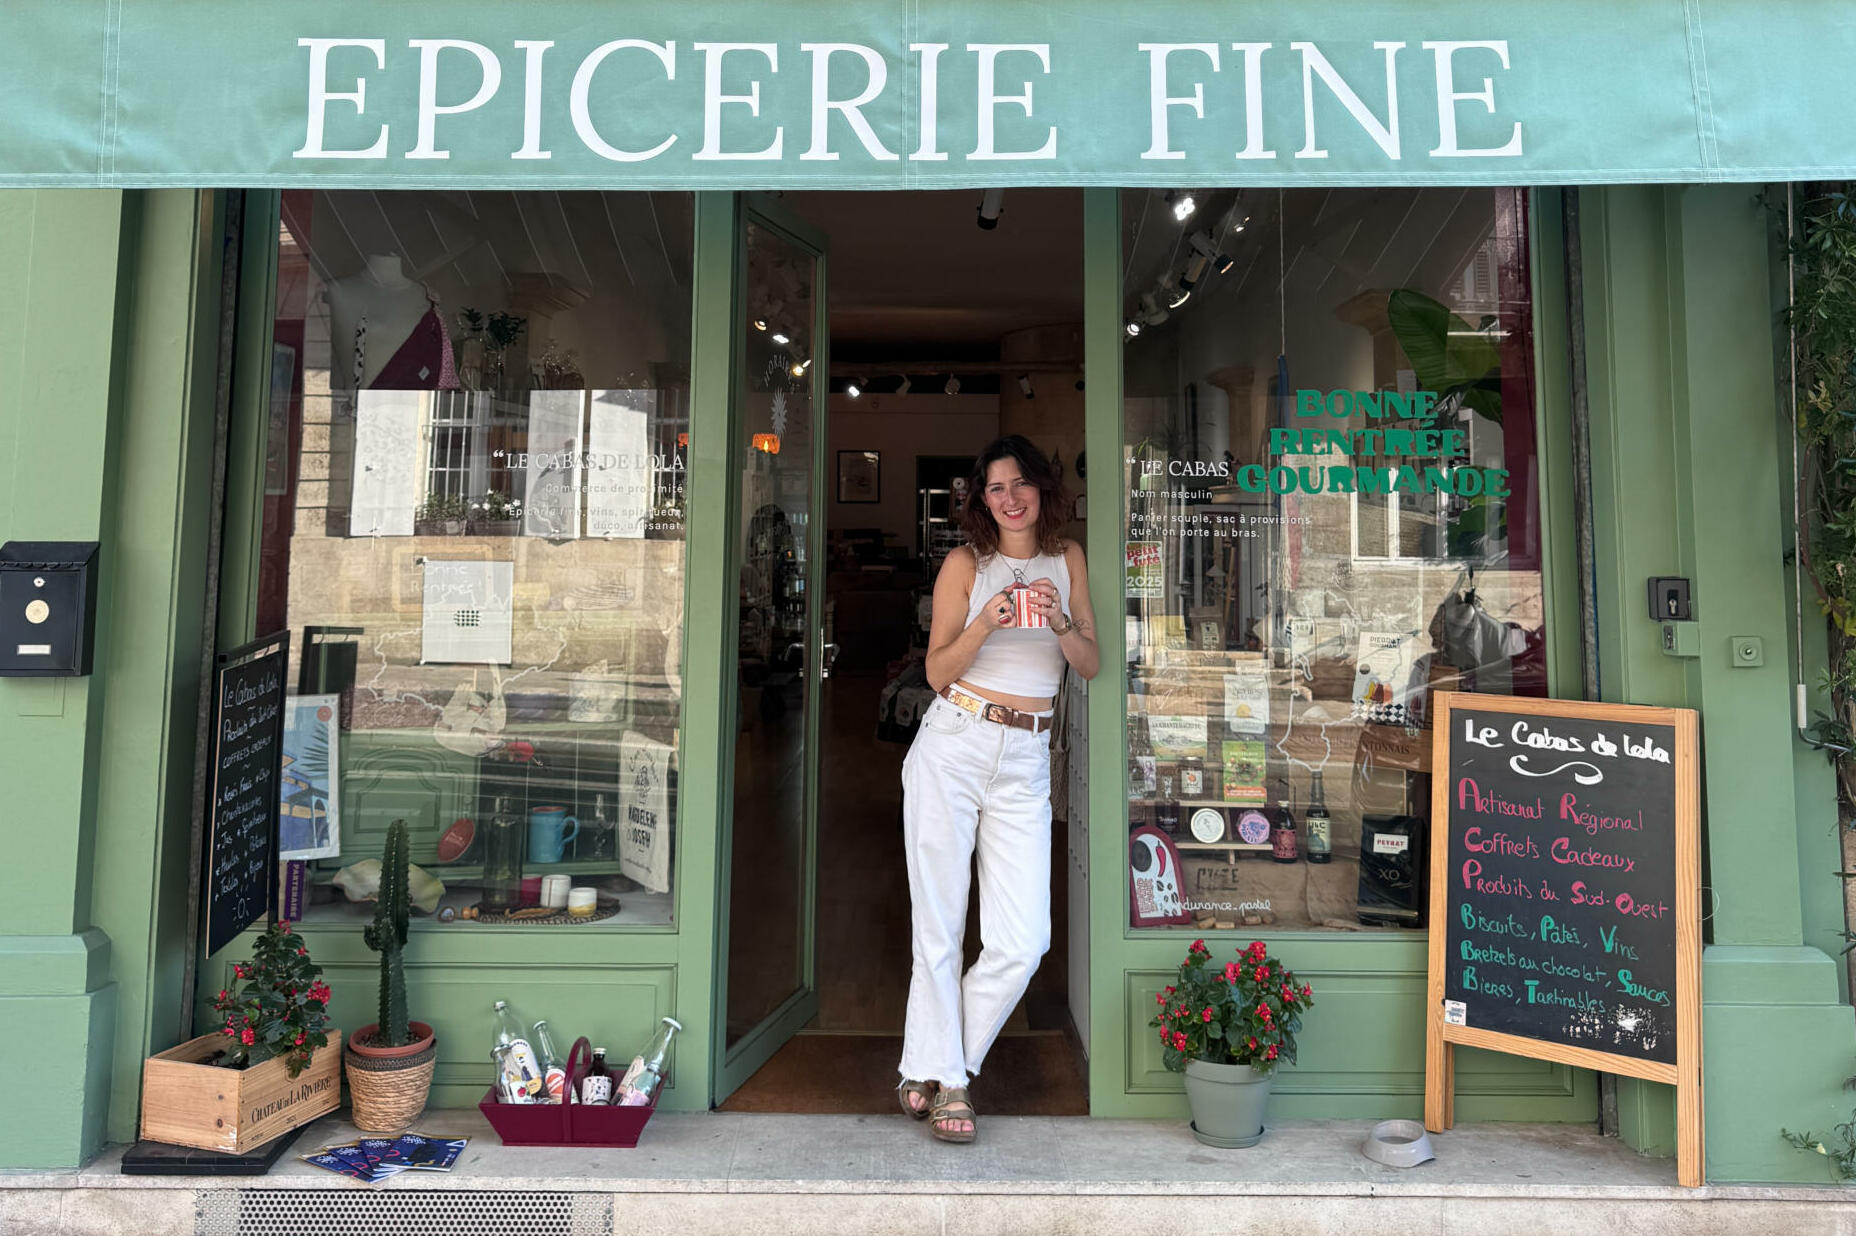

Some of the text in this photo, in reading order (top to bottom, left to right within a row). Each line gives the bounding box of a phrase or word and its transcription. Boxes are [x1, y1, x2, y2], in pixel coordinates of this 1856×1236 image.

[292, 38, 1524, 162] EPICERIE FINE
[1295, 388, 1438, 420] BONNE
[1269, 419, 1466, 457] RENTRÉE
[535, 452, 596, 470] CABAS
[602, 454, 629, 469] DE
[634, 454, 685, 470] LOLA
[1168, 460, 1229, 477] CABAS
[628, 483, 684, 496] proimité
[1131, 489, 1213, 499] Nom masculin
[1236, 463, 1511, 498] GOURMANDE
[1131, 512, 1311, 527] Panier souple, sac à provisions
[1131, 526, 1260, 538] que l'on porte au bras.
[1127, 575, 1162, 588] 2025
[1465, 718, 1505, 748] Le
[1511, 720, 1586, 753] Cabas
[1591, 733, 1619, 758] de
[1458, 777, 1645, 836] Artisanat Régional
[1376, 839, 1404, 848] PEYRAT
[1464, 826, 1636, 873] Coffrets Cadeaux
[1379, 868, 1400, 881] XO
[1461, 858, 1532, 900] Produits
[1540, 879, 1560, 902] du
[1599, 925, 1640, 961] Vins
[1460, 940, 1517, 968] Bretzels
[1519, 956, 1539, 971] au
[1616, 968, 1672, 1008] Sauces
